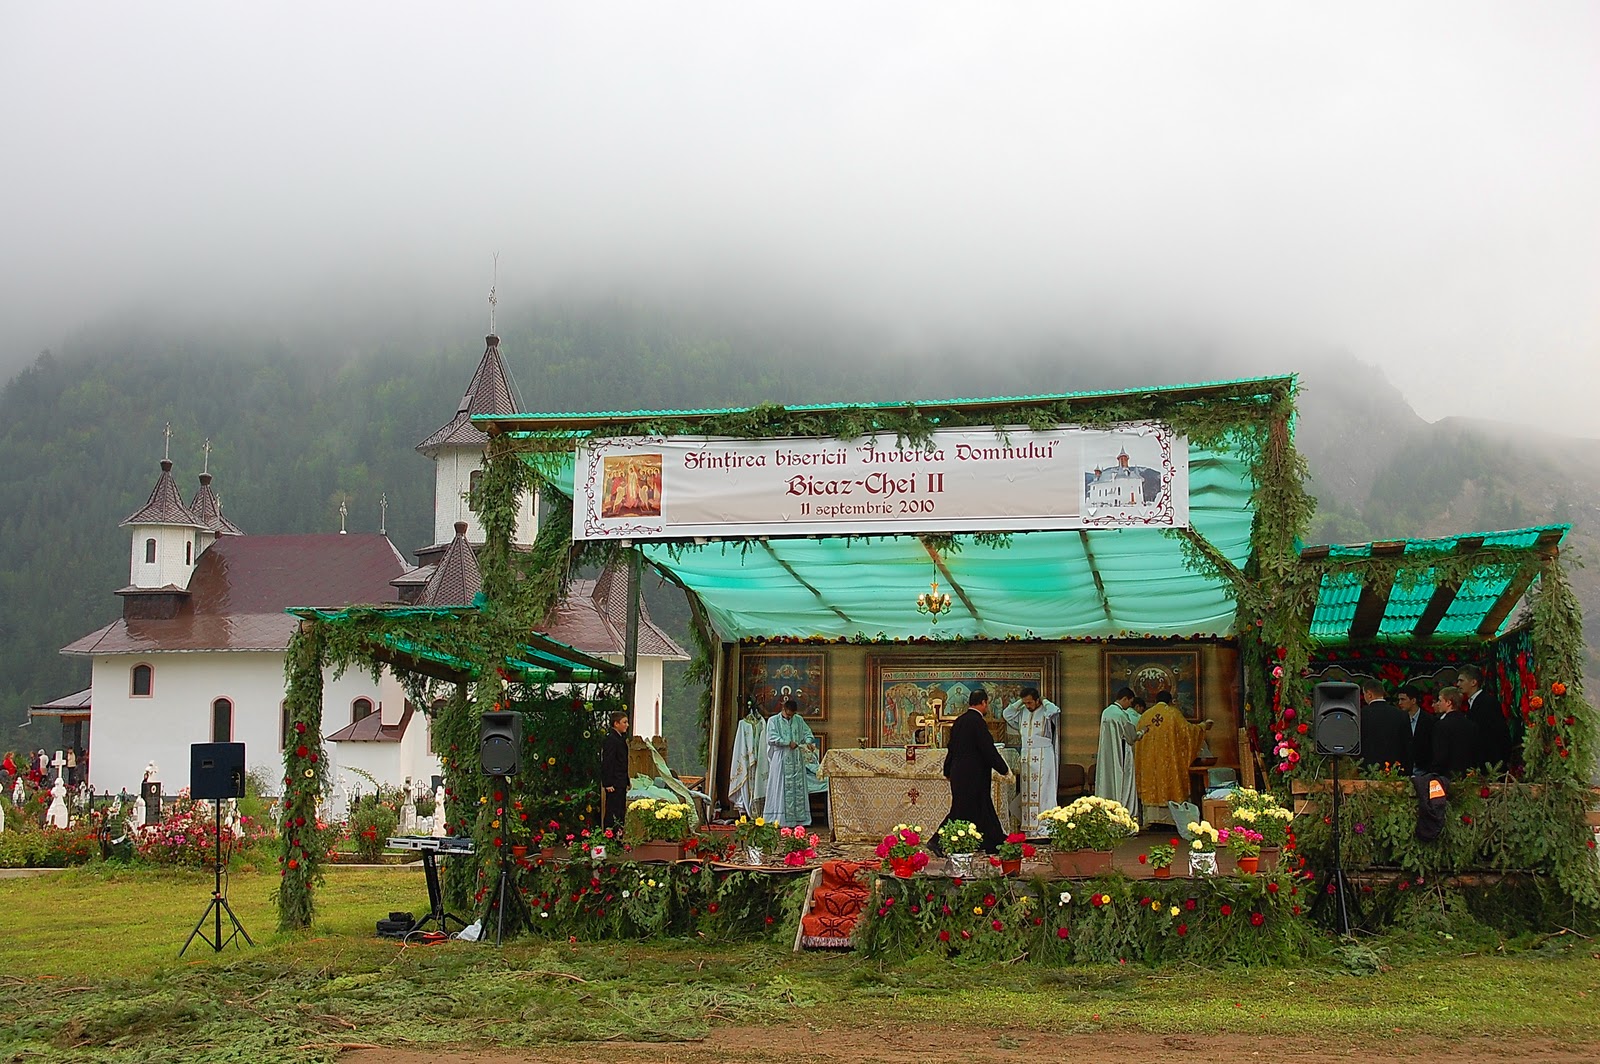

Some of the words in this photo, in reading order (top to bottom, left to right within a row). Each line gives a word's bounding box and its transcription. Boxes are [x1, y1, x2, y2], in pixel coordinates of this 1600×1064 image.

[775, 447, 848, 467] bisericii
[785, 472, 917, 500] Bicaz-Chei
[927, 473, 945, 493] II
[800, 502, 811, 514] 11
[815, 501, 893, 517] septembrie
[898, 499, 936, 513] 2010
